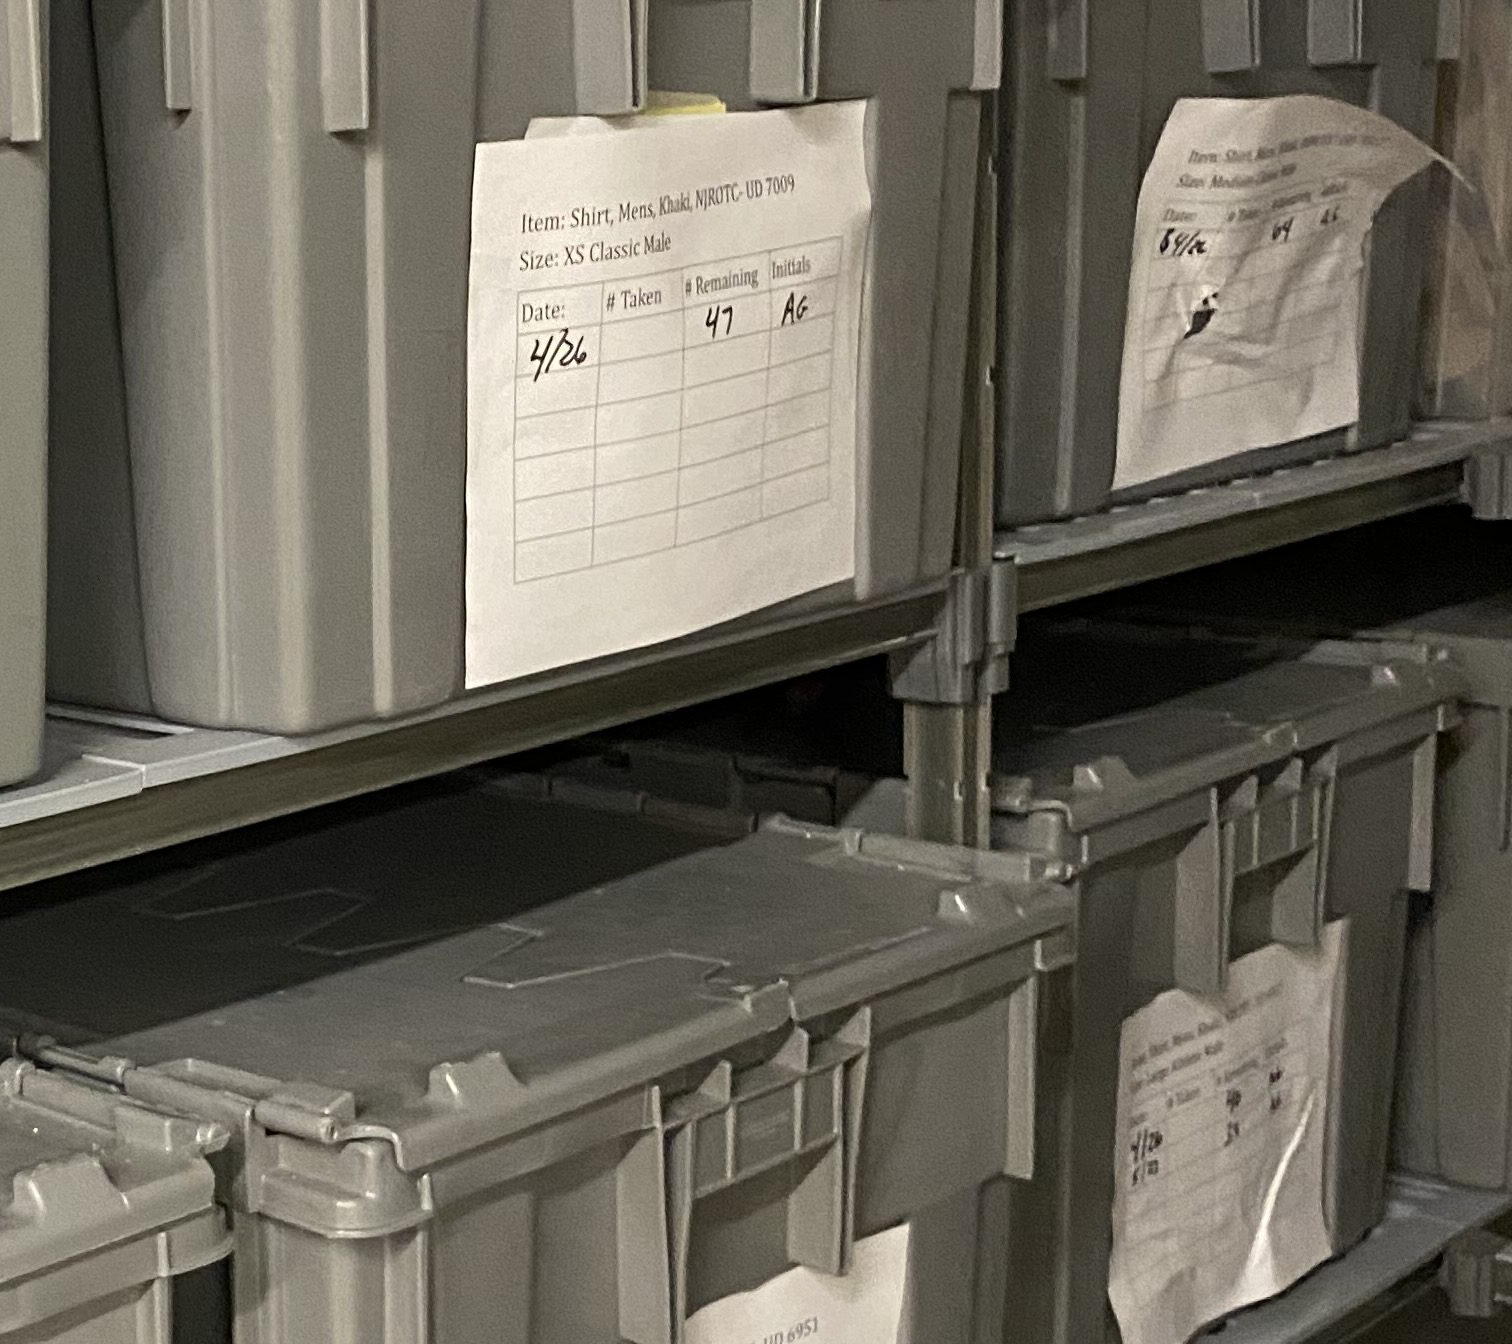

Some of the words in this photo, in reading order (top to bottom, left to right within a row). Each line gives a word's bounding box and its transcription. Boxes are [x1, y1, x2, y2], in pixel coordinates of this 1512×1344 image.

[521, 213, 566, 234] Item:
[570, 208, 614, 228] Shirt,
[618, 201, 656, 221] Mens,
[659, 194, 693, 216] Khaki,
[695, 181, 743, 211] NJROTC-
[746, 179, 763, 200] UD
[766, 173, 795, 195] 7009
[519, 250, 560, 272] Size:
[563, 243, 585, 266] XS
[589, 235, 640, 263] Classic
[643, 232, 672, 254] Male
[695, 266, 759, 296] Remaining
[771, 257, 811, 280] Initials
[522, 302, 566, 324] Date:
[606, 293, 616, 310] #
[620, 288, 662, 308] Taken
[705, 305, 733, 339] 47
[787, 1316, 819, 1344] 6951
